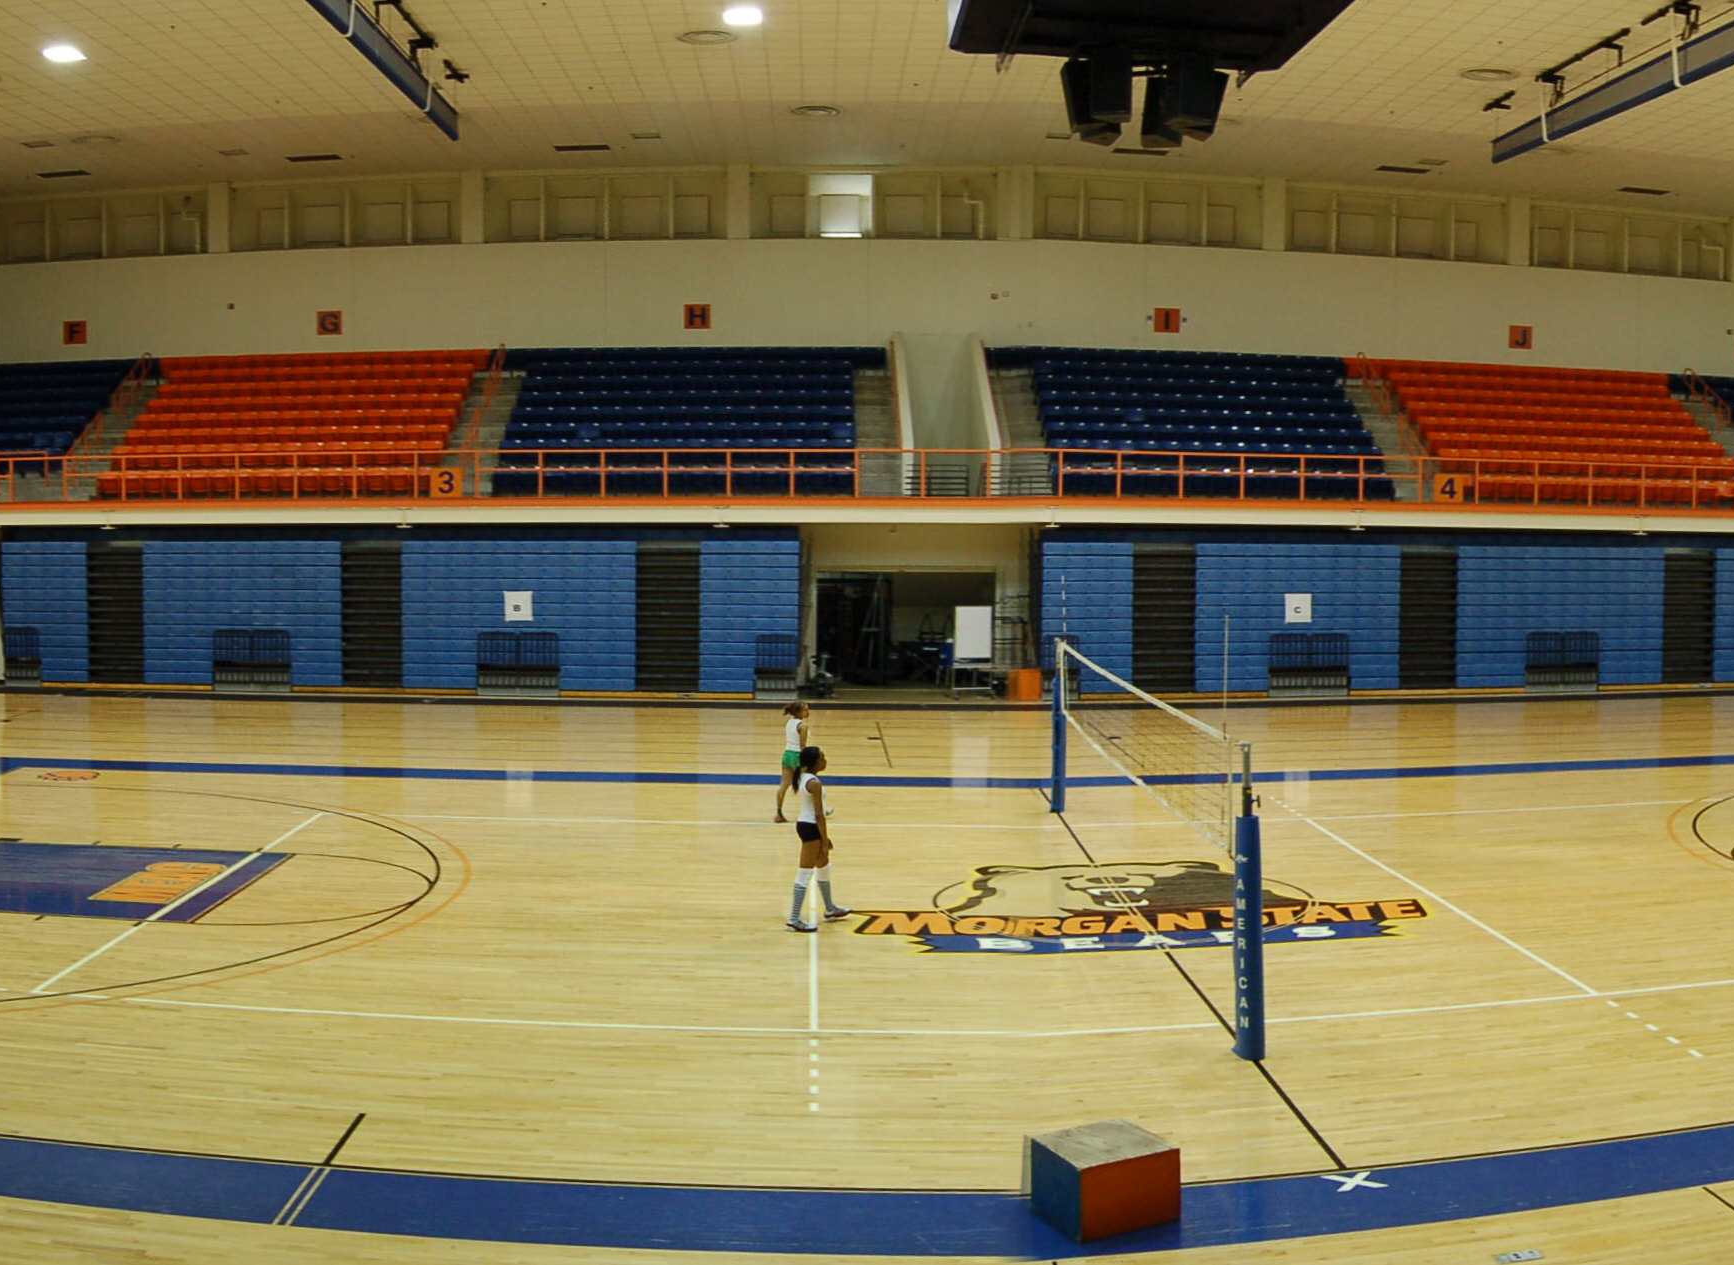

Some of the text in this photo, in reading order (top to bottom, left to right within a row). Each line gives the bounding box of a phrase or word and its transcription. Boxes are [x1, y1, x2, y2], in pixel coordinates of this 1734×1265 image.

[320, 313, 339, 332] G
[689, 307, 706, 326] H
[68, 323, 82, 342] F
[1515, 328, 1528, 346] J
[438, 471, 454, 493] 3
[1440, 477, 1457, 499] 4
[864, 911, 1207, 935] MORGAN
[1236, 878, 1249, 1029] AMERICAN
